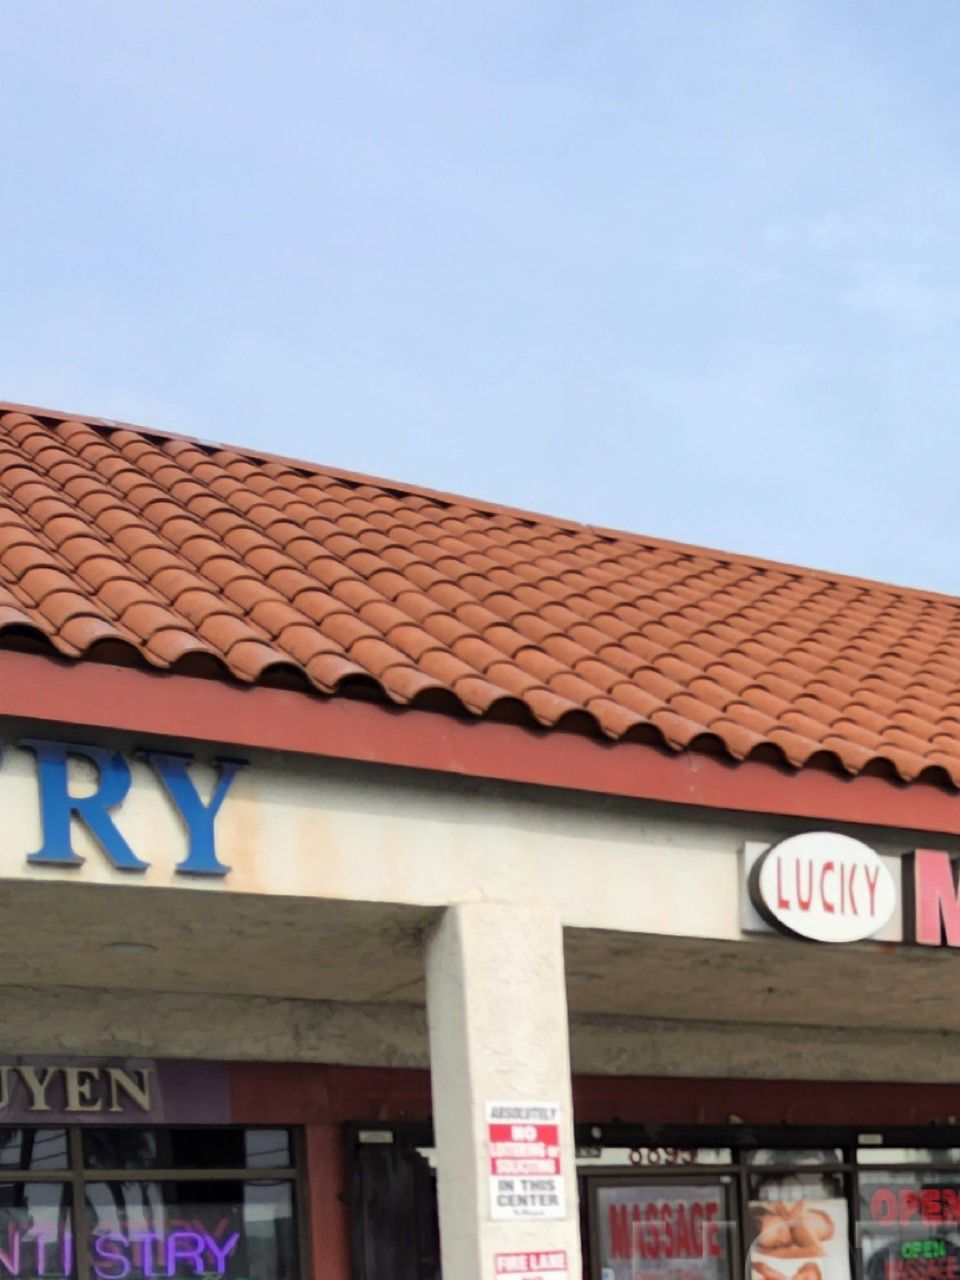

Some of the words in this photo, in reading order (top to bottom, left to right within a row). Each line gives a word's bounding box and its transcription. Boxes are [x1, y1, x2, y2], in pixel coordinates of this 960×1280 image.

[776, 855, 881, 919] LUCKY
[511, 1125, 538, 1142] NO
[498, 1179, 514, 1191] IN
[521, 1179, 556, 1191] THIS
[497, 1194, 560, 1207] CENTER
[608, 1201, 722, 1260] MASSAGE
[901, 1240, 946, 1259] OPEN
[496, 1253, 528, 1272] FIRE
[529, 1252, 565, 1271] LANE
